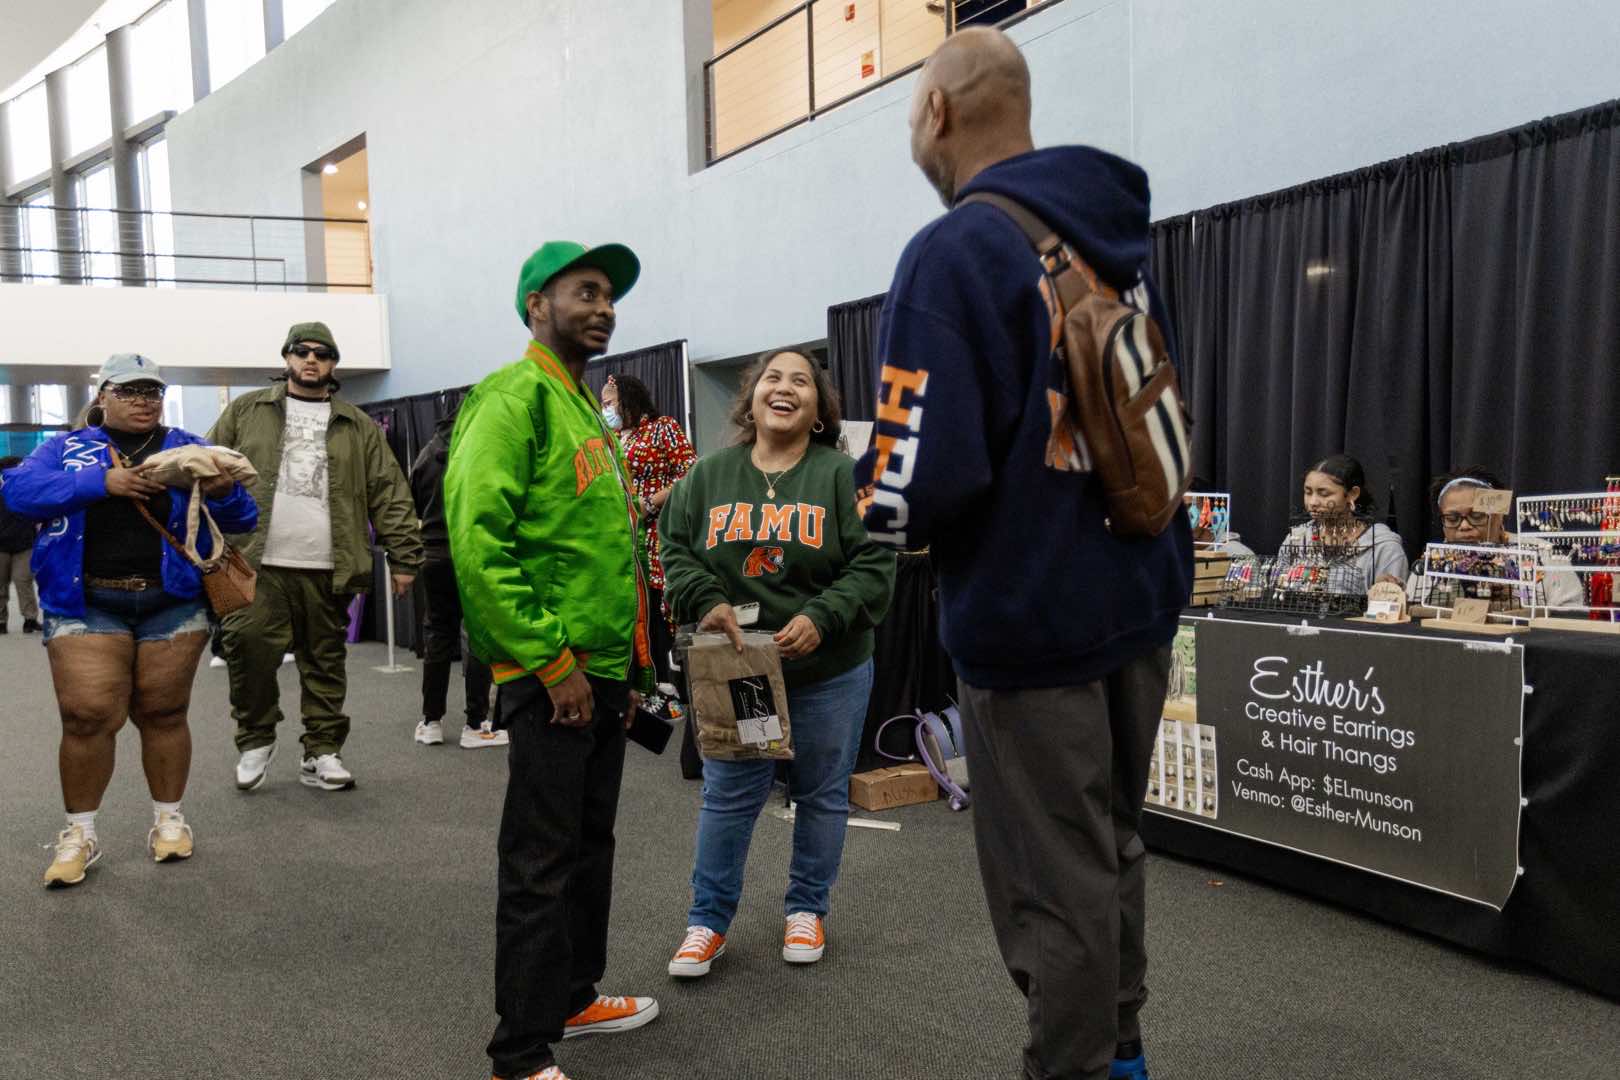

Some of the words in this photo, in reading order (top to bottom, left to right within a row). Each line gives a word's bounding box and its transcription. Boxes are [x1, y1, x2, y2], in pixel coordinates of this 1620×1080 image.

[705, 502, 826, 550] FAMU
[1250, 656, 1385, 715] Esther's
[1245, 701, 1327, 731] Creative
[1333, 715, 1415, 749] Earrings
[1261, 730, 1275, 748] &
[1280, 732, 1318, 756] Hair
[1322, 740, 1398, 774] Thangs
[1231, 780, 1286, 808] Venmo:
[1290, 794, 1423, 842] @Esther-Munson
[1236, 758, 1274, 781] Cash
[1278, 767, 1316, 792] App:
[1323, 774, 1414, 813] $ELmunson
